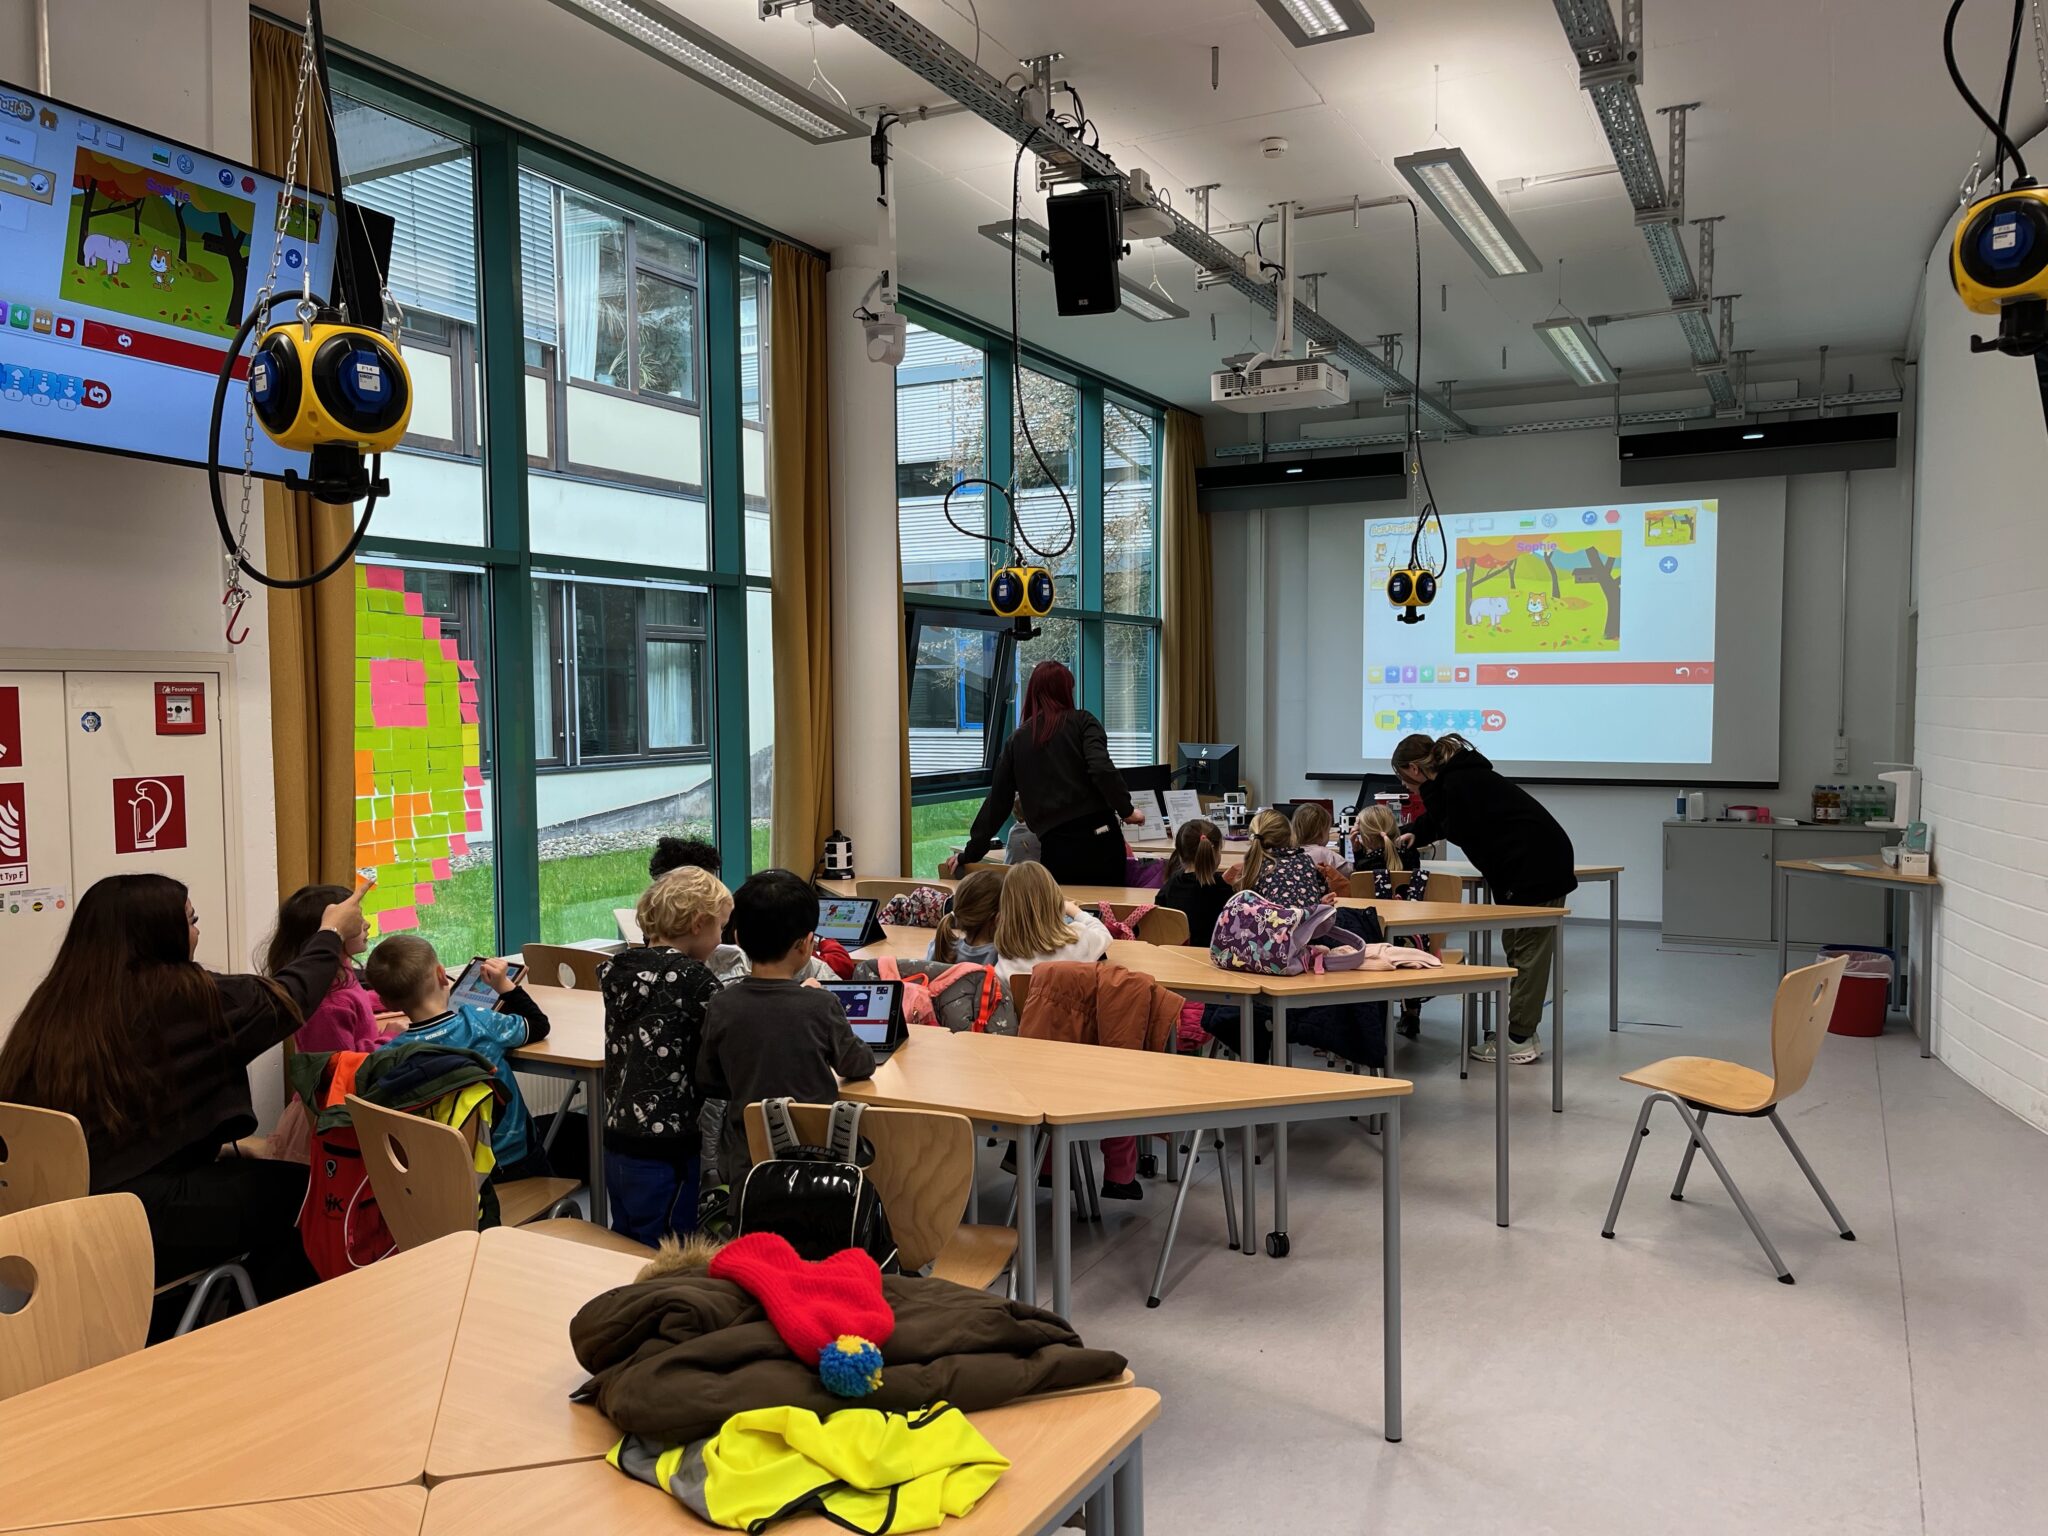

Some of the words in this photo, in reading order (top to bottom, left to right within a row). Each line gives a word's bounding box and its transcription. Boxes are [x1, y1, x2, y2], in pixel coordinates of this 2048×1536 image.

[146, 177, 190, 201] Sophie
[1516, 542, 1557, 554] Sophie
[4, 872, 18, 882] Typ
[19, 870, 24, 879] F
